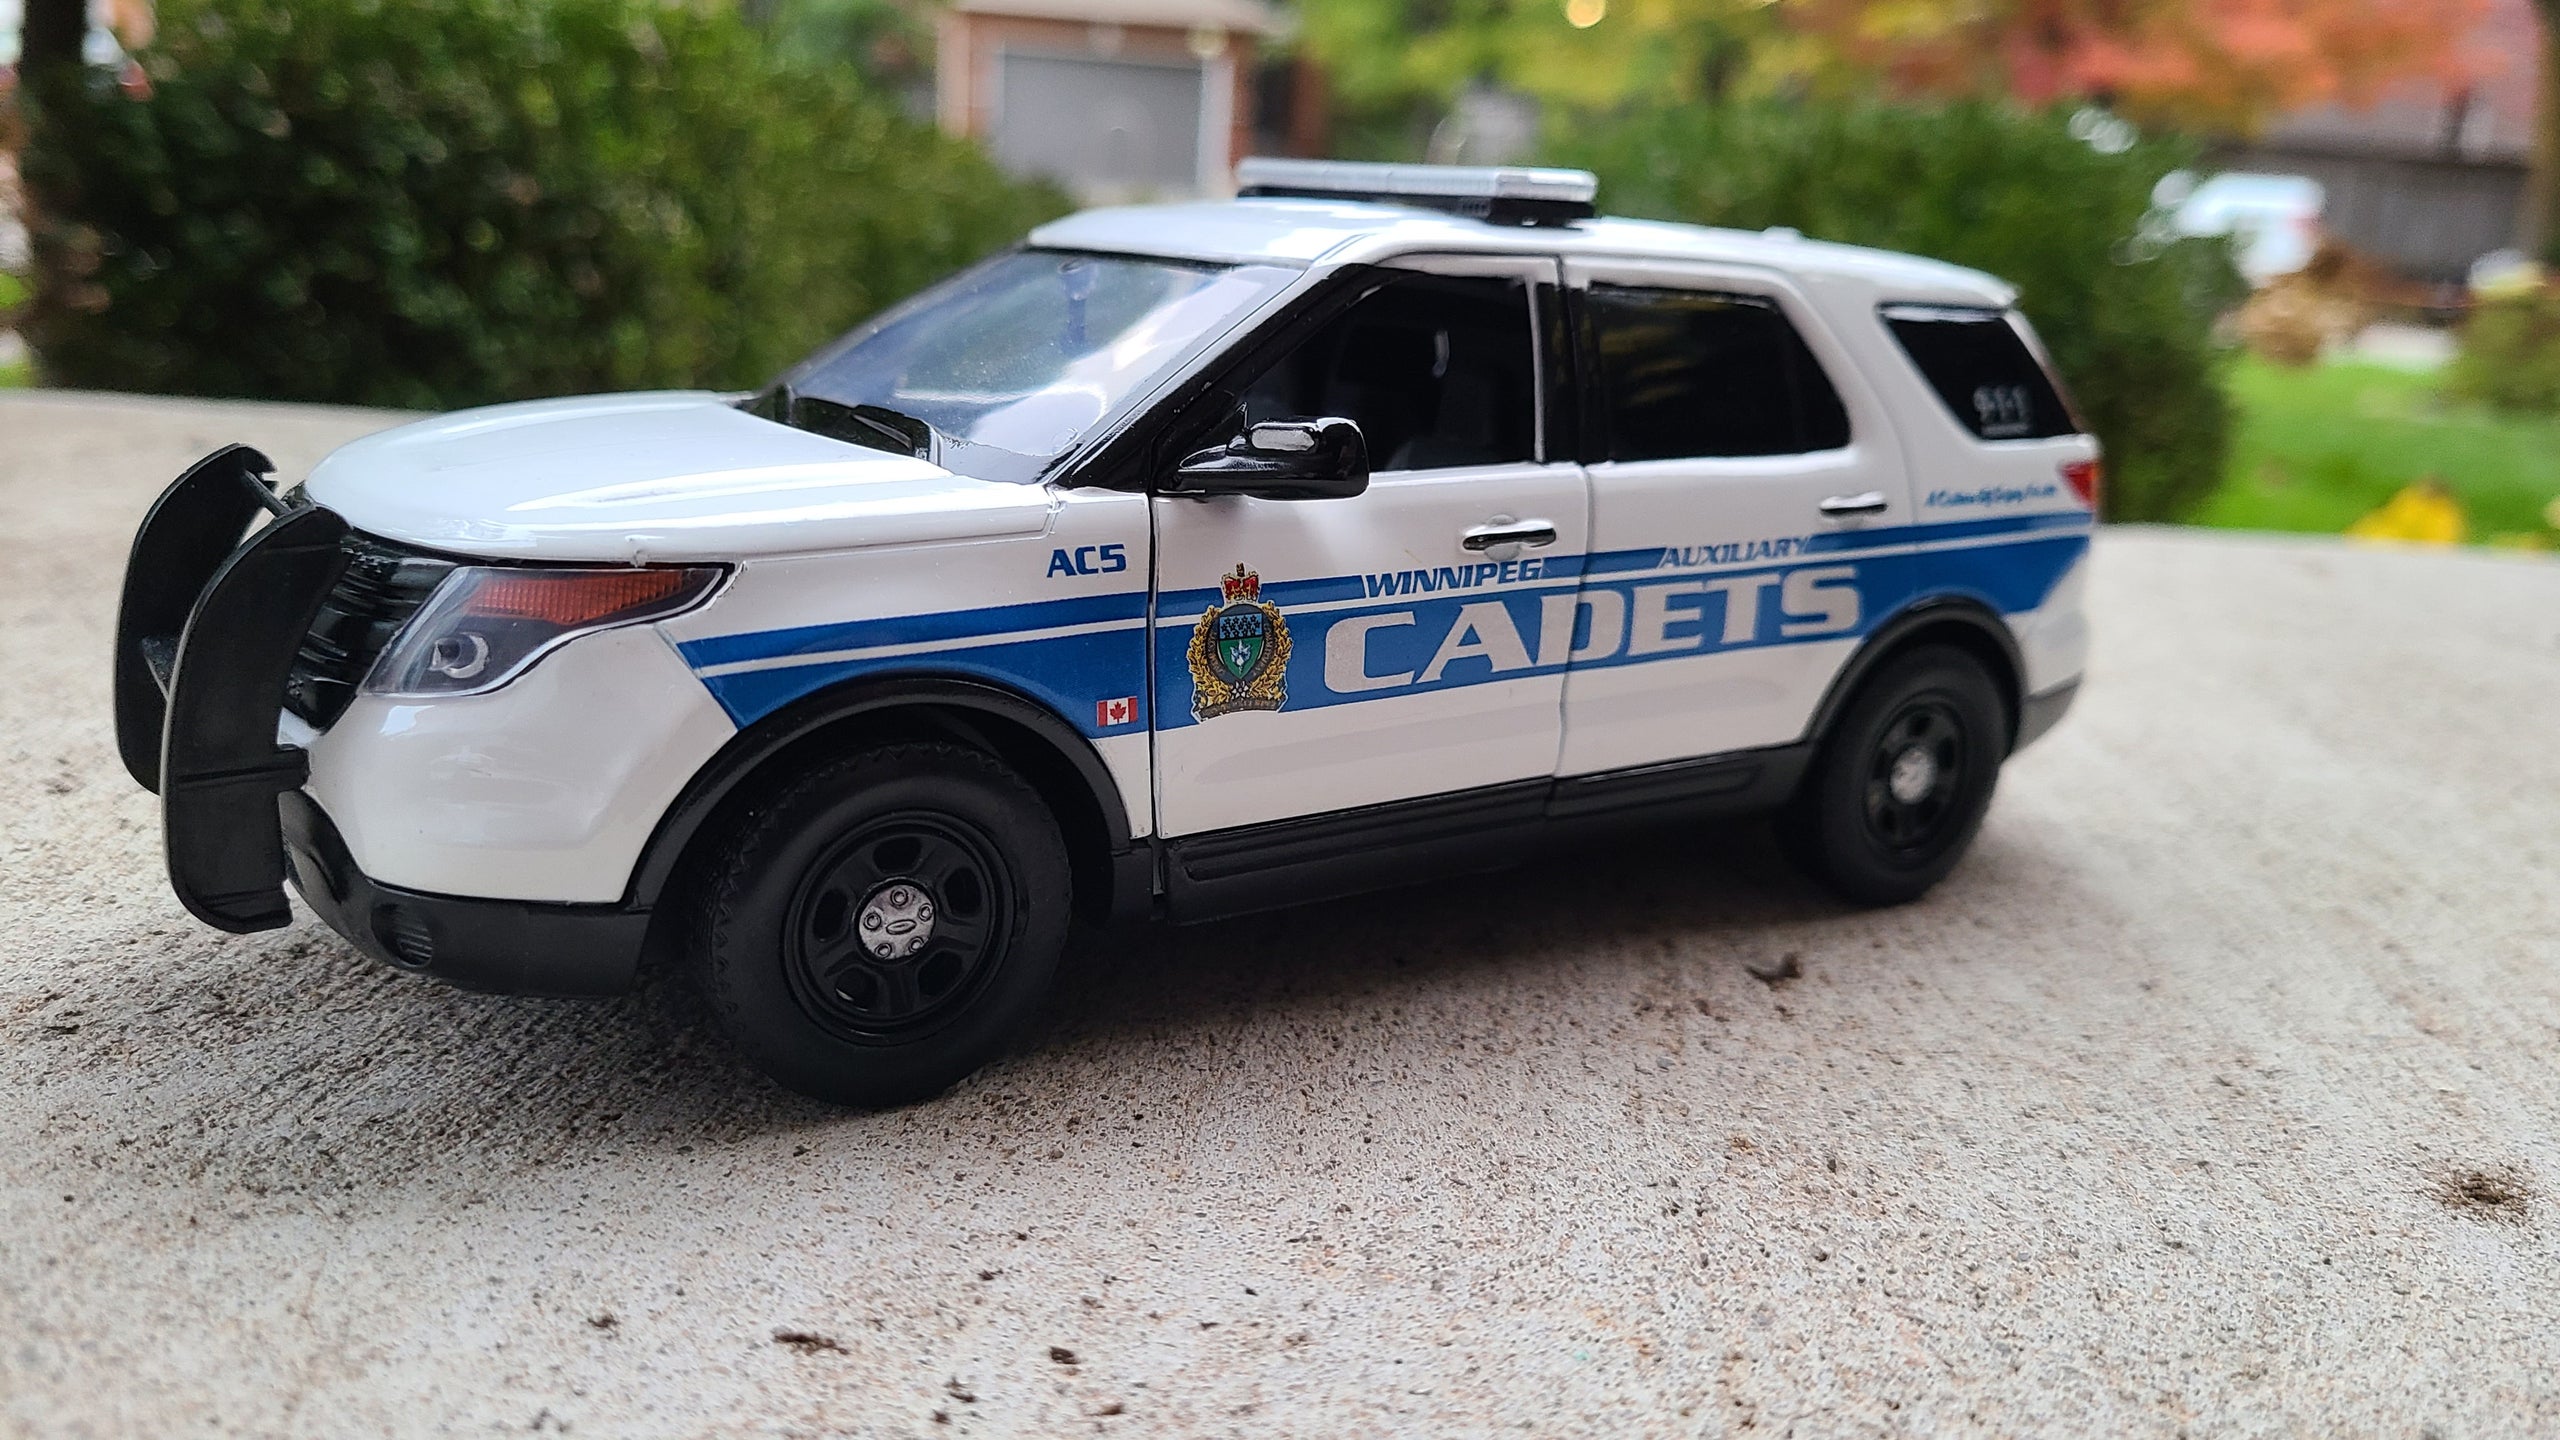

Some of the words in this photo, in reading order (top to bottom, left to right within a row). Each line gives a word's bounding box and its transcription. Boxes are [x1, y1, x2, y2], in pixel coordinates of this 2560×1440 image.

[1659, 536, 1810, 568] AUXILIARY
[1365, 558, 1543, 598] WINNIPEG
[1325, 566, 1861, 693] CADETS
